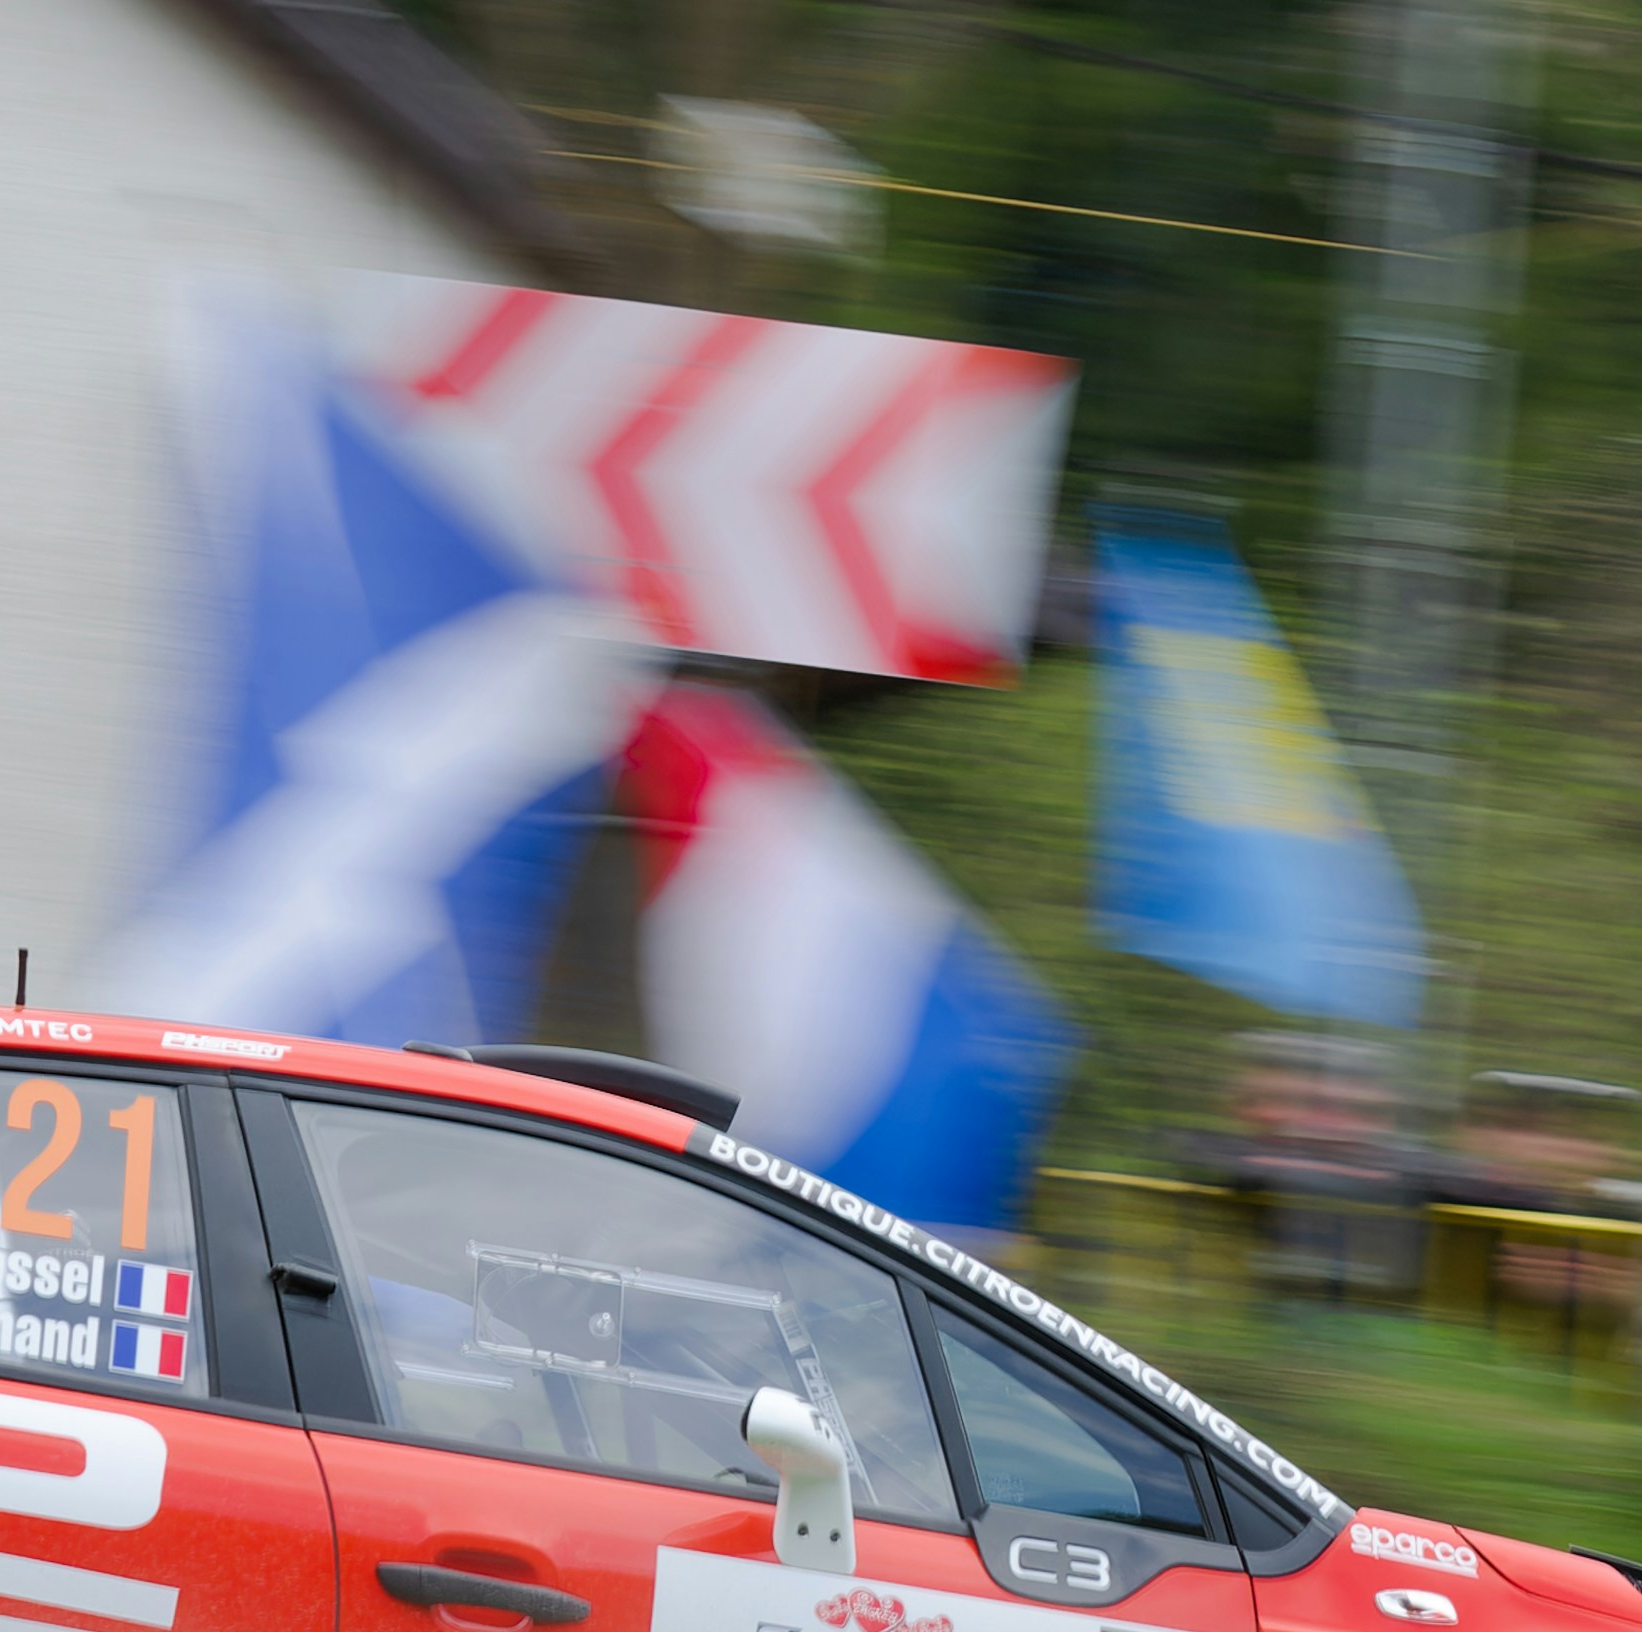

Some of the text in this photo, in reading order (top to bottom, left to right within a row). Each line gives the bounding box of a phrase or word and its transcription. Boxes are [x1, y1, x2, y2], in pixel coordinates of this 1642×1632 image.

[0, 1077, 154, 1251] 21
[707, 1133, 1337, 1518] BOUTIQUE.CITROENRACING.COM
[1009, 1536, 1110, 1592] C3
[1350, 1523, 1478, 1568] sparco
